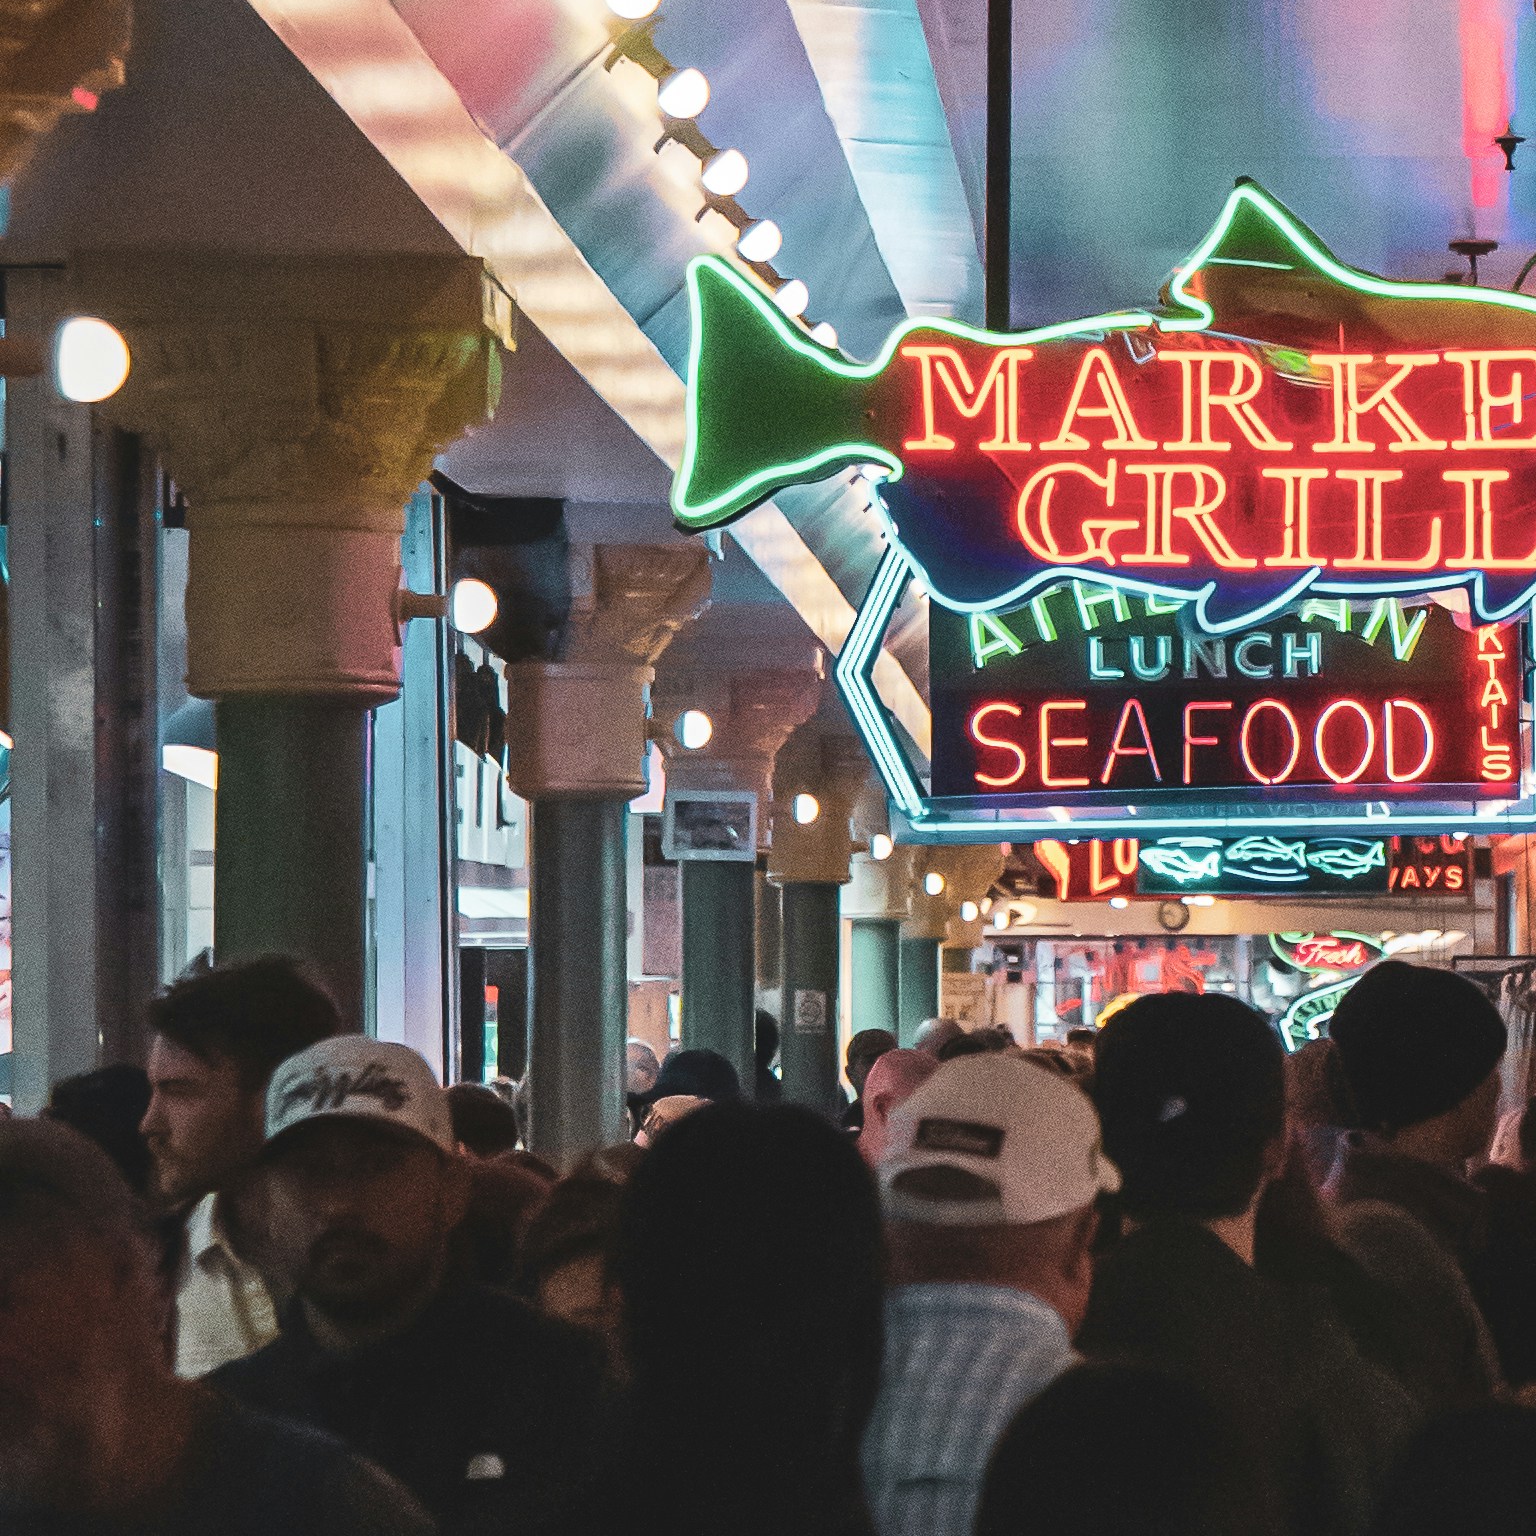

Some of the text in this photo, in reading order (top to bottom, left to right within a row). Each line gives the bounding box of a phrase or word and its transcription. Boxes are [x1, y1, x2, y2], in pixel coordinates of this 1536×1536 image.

[1088, 630, 1323, 681] LUNCH
[1476, 622, 1513, 781] KTAILS
[969, 698, 1436, 786] SEAFOOD
[1290, 937, 1366, 965] Fresh
